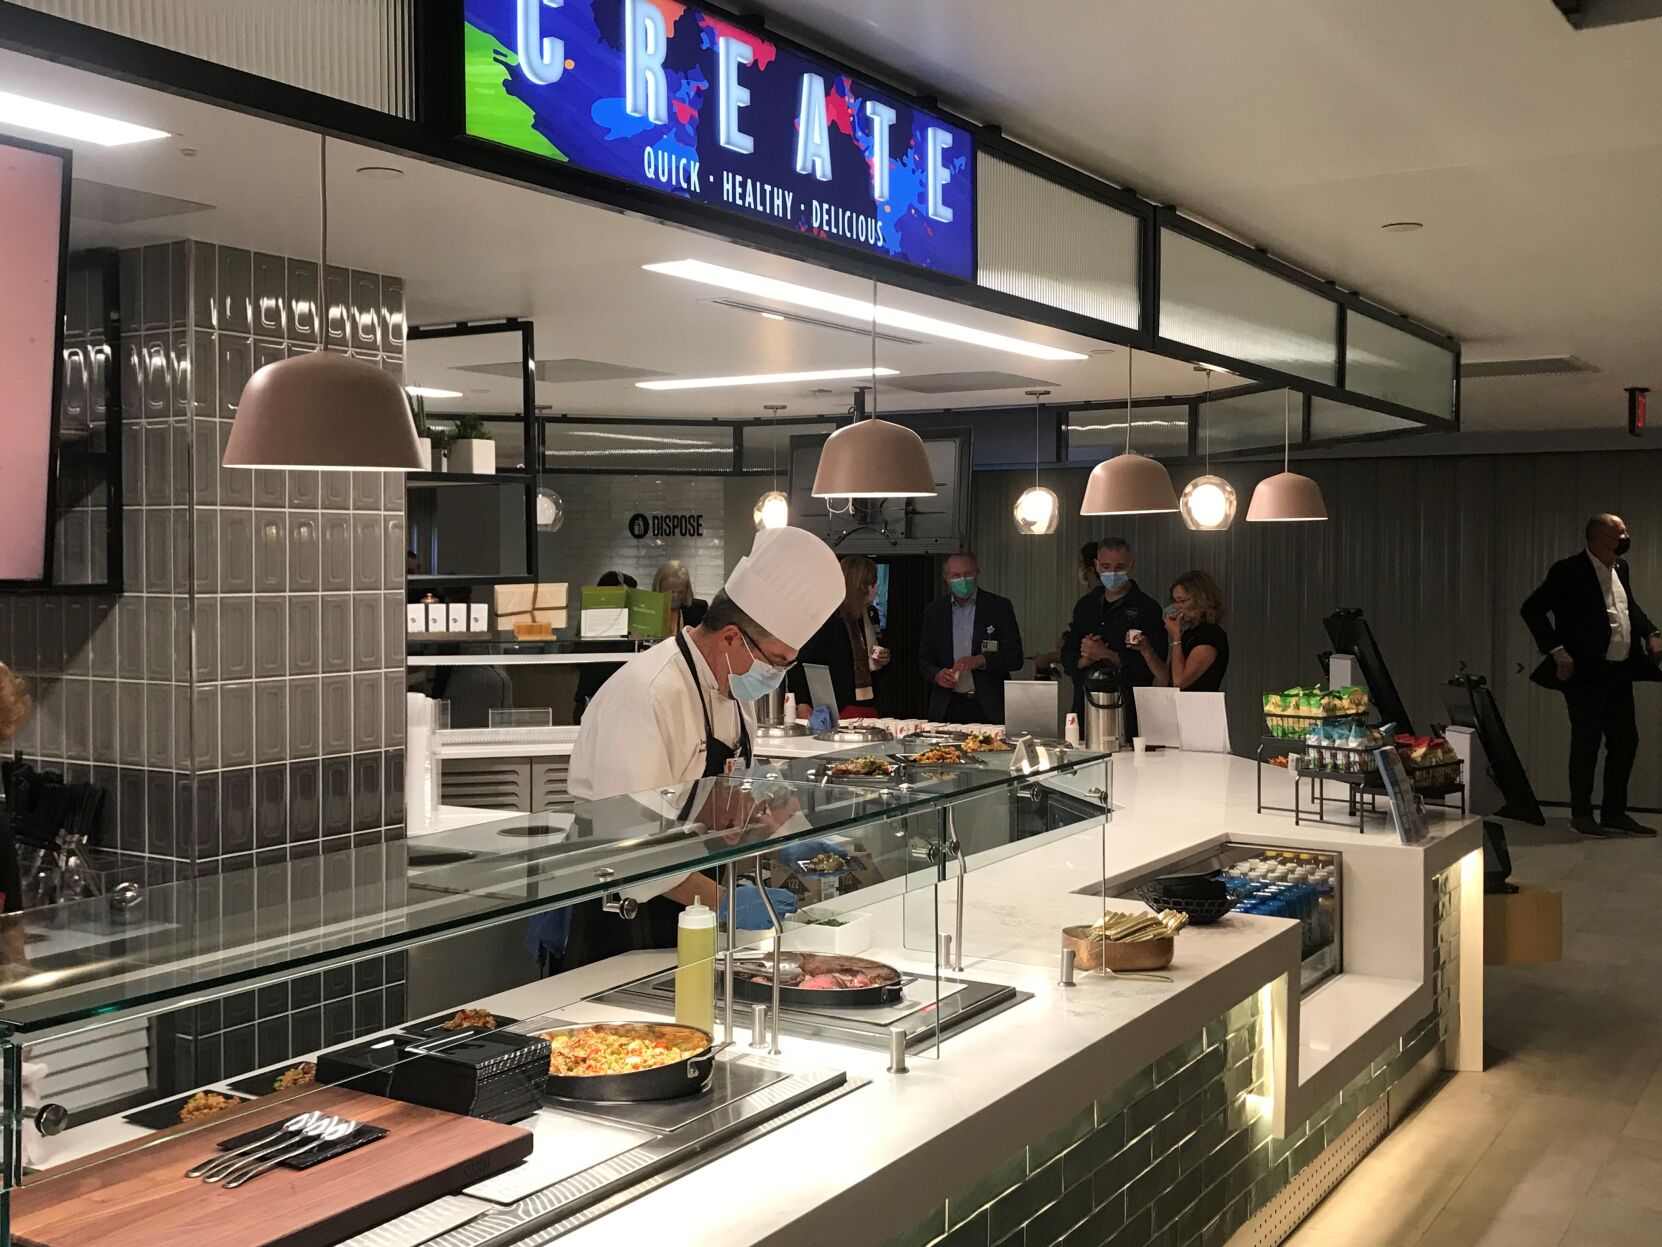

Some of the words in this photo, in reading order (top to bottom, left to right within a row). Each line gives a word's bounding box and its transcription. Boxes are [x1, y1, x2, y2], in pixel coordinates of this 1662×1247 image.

[517, 0, 955, 223] CREATE
[643, 146, 701, 193] QUICK
[722, 171, 793, 220] HEALTHY
[811, 200, 885, 247] DELICIOUS
[652, 514, 703, 537] DISPOSE
